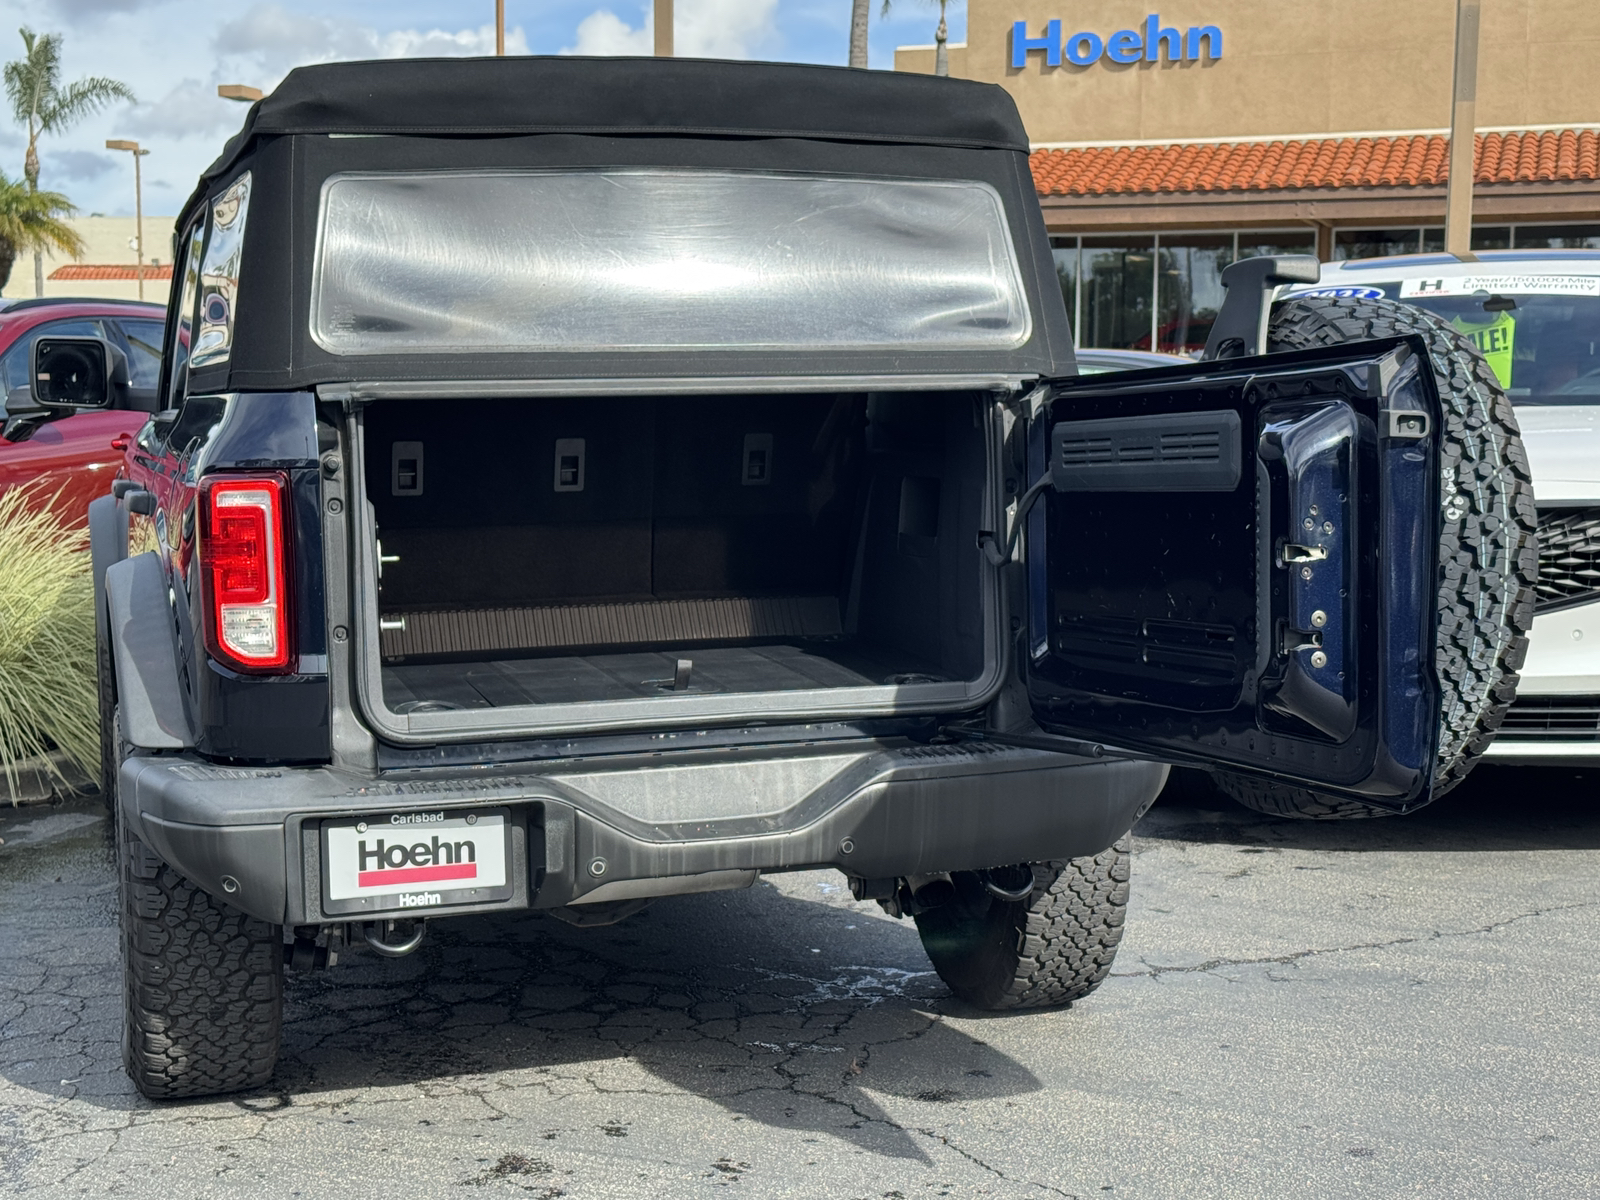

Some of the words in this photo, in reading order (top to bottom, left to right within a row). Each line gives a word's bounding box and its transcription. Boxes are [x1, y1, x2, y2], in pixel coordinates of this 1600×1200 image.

[1010, 14, 1223, 69] Hoehn
[1419, 279, 1443, 291] H
[1462, 282, 1519, 290] Limited
[1523, 282, 1596, 291] Warranty
[1568, 277, 1596, 285] Mile
[1466, 326, 1509, 354] ALE!
[390, 811, 445, 826] Carlsbad
[358, 835, 476, 872] Hoehn
[399, 891, 441, 908] Hoehn
